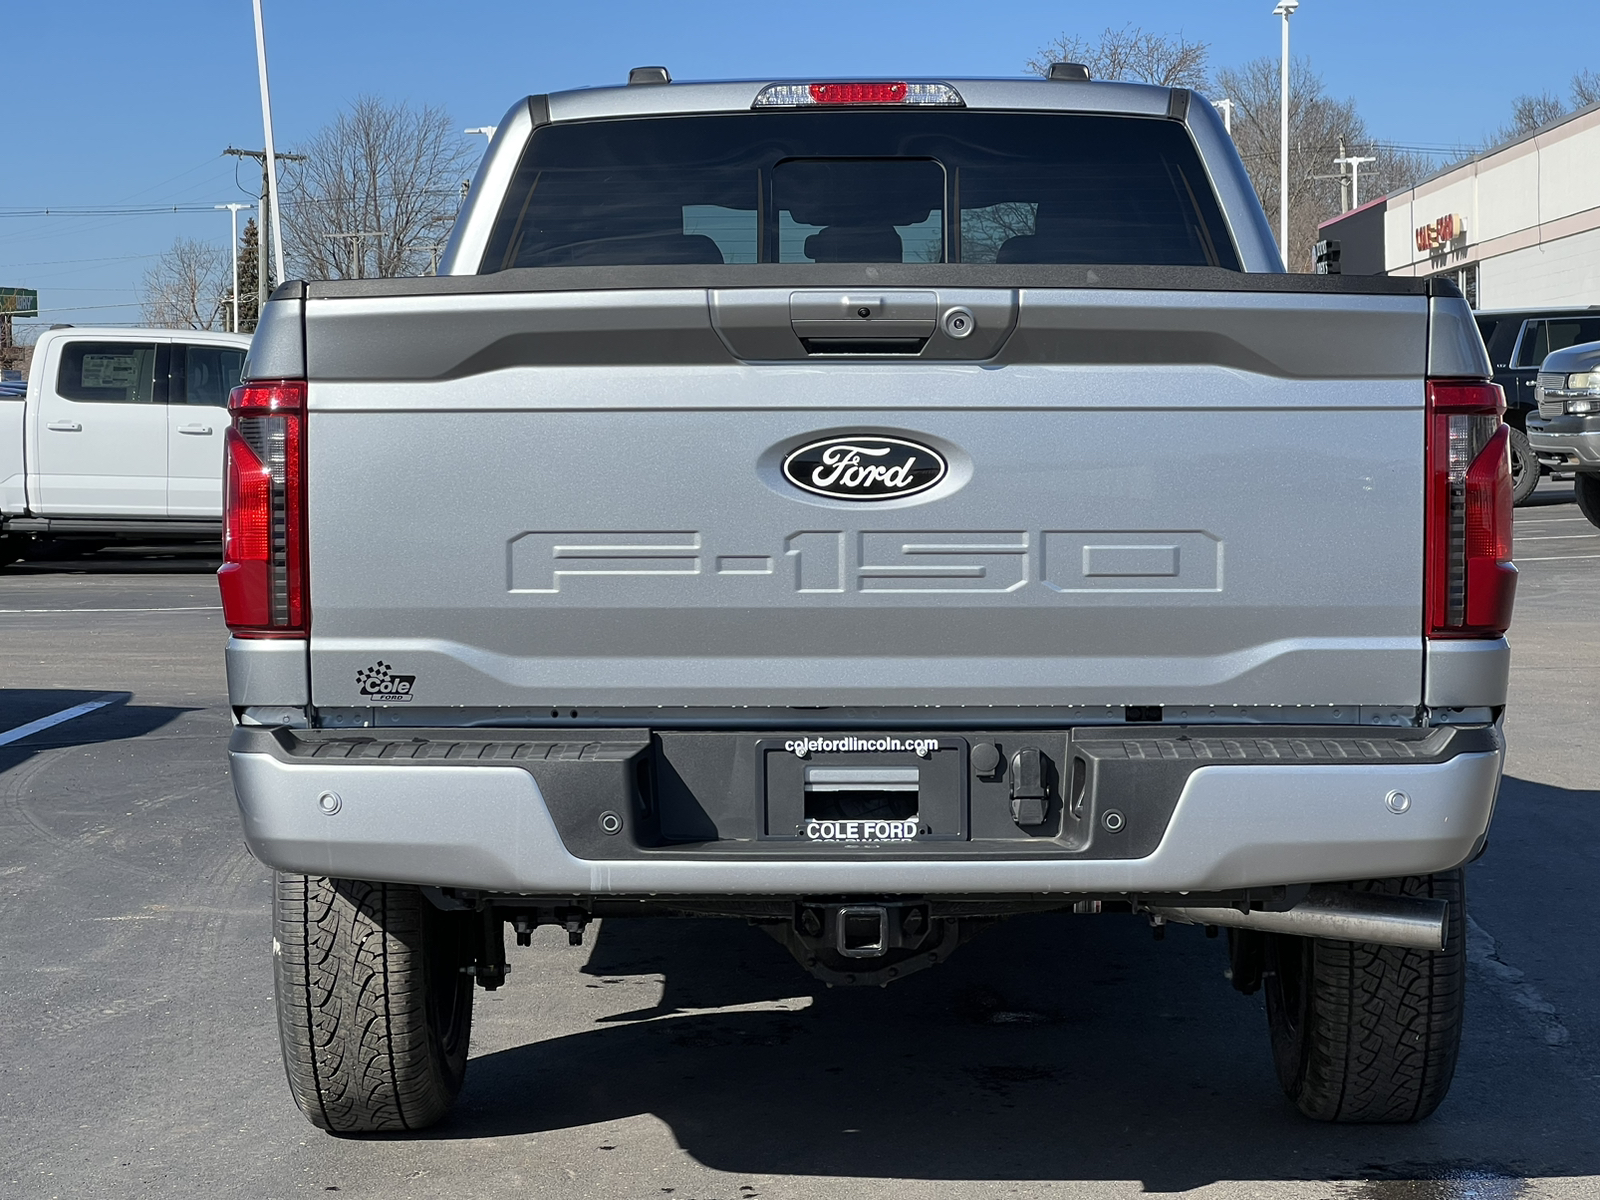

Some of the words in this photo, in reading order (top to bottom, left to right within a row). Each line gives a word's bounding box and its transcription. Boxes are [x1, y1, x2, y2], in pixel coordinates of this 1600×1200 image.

[811, 445, 916, 488] Ford
[507, 530, 1225, 594] F-150
[365, 677, 410, 693] Cole
[785, 737, 939, 751] colefordlincoln.com
[806, 822, 859, 839] COLE
[864, 822, 917, 839] FORD
